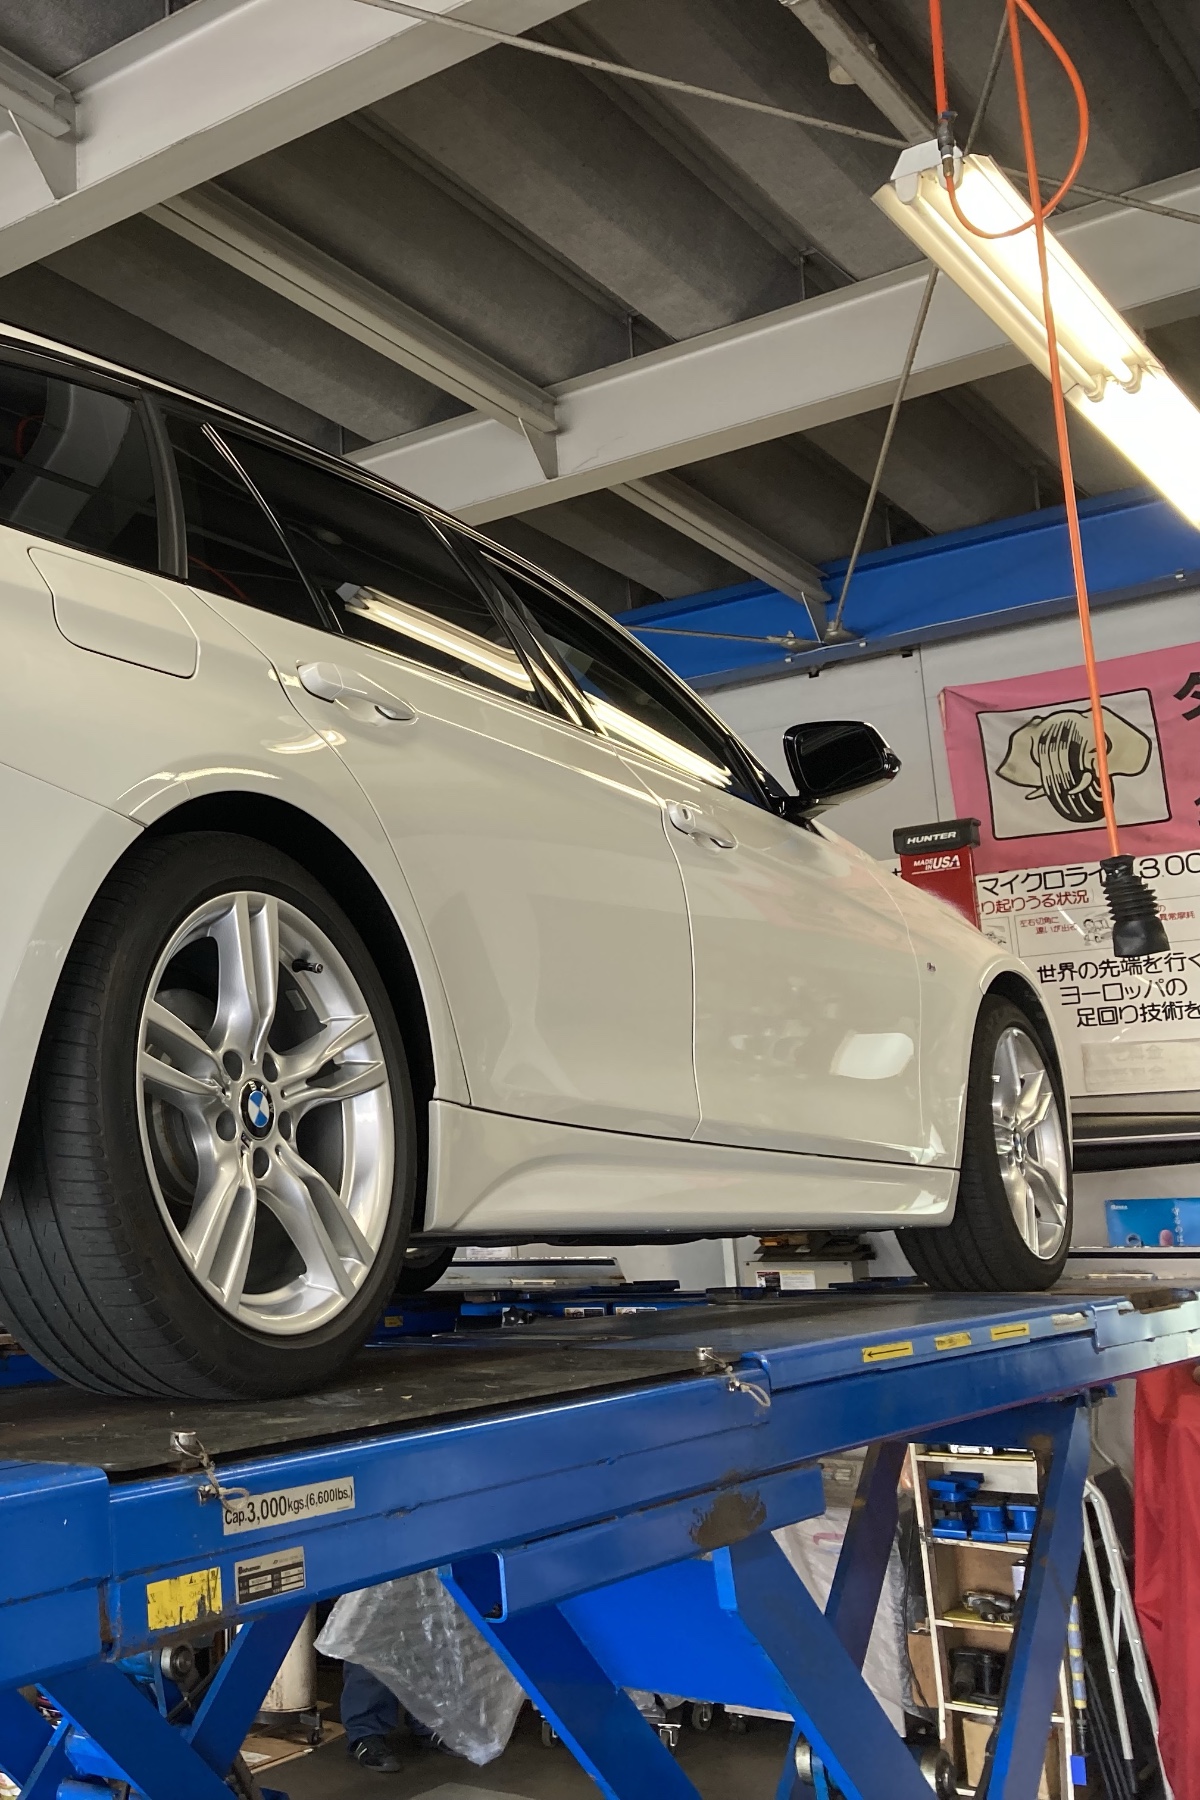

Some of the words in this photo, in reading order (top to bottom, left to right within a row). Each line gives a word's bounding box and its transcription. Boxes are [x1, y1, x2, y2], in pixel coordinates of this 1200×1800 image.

[906, 831, 957, 845] HUNTER
[913, 858, 934, 867] MADE
[933, 854, 960, 869] USA
[977, 889, 1090, 915] り起りうる状況
[1037, 952, 1200, 984] 世界の先端を行く
[1059, 977, 1188, 1006] ヨーロッパの
[1077, 1000, 1200, 1028] 足回り技術を
